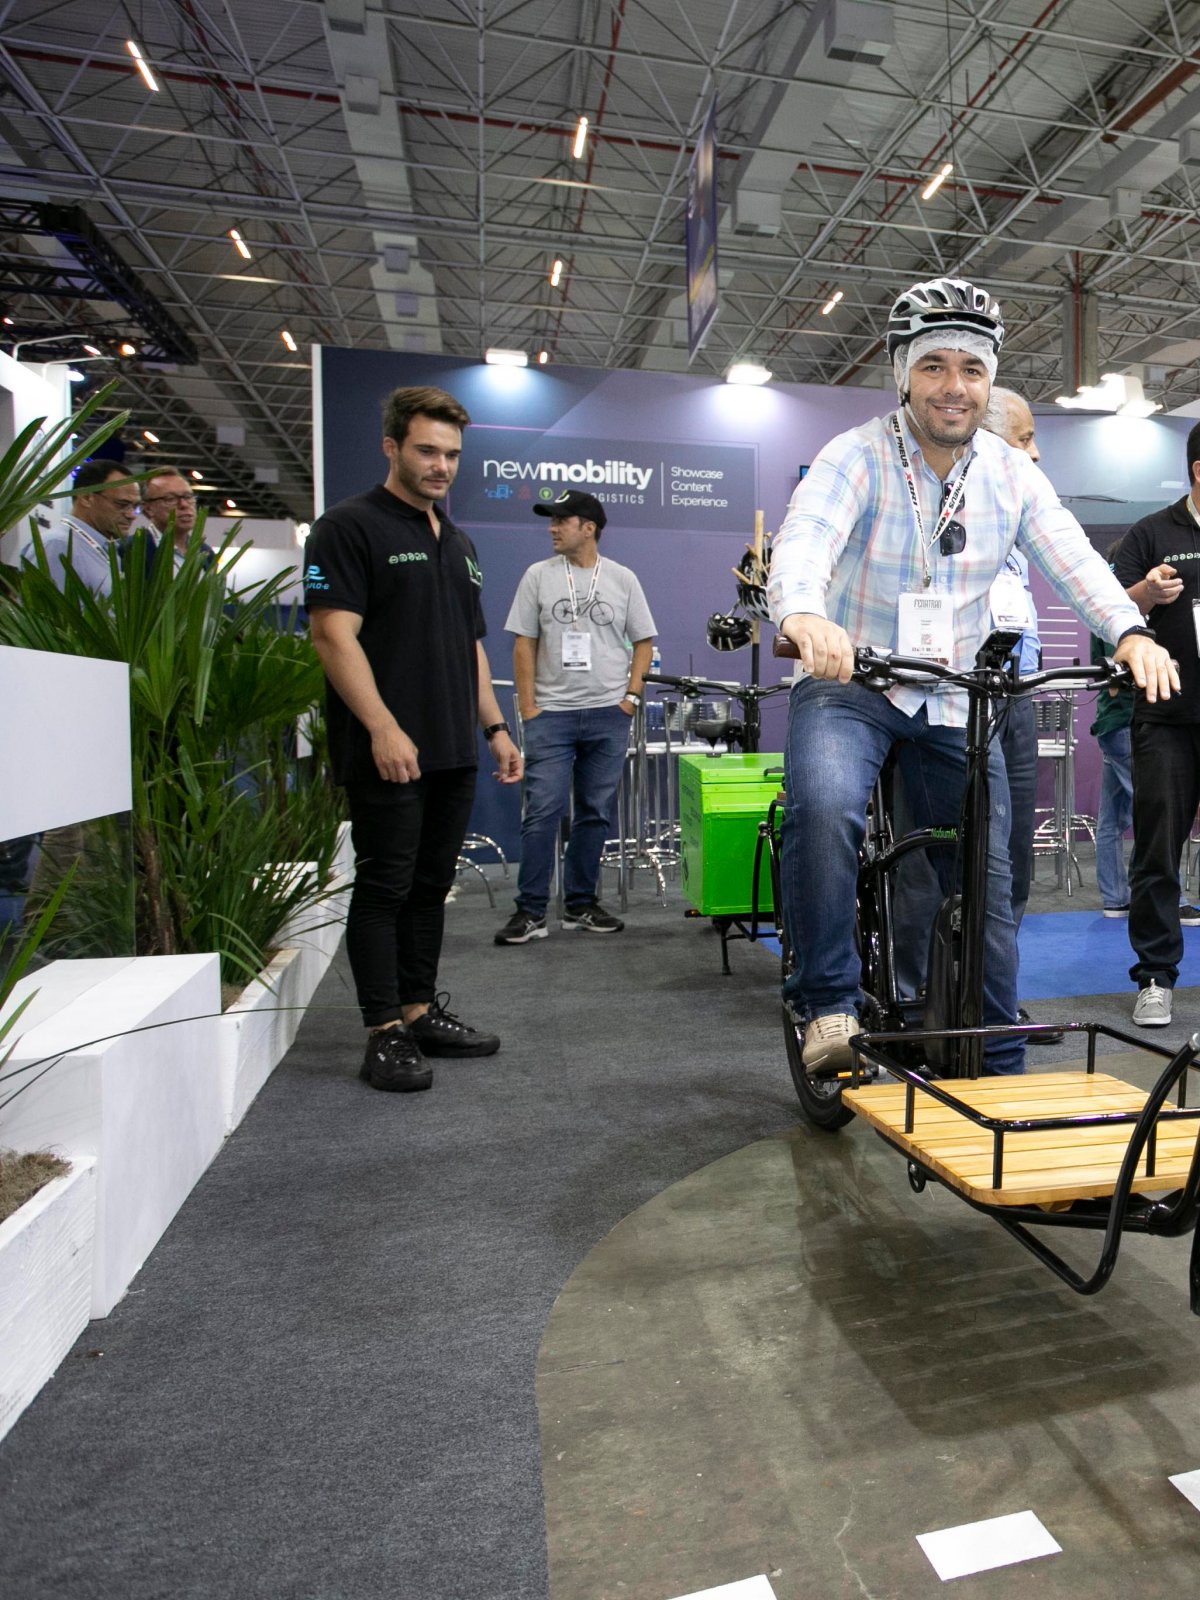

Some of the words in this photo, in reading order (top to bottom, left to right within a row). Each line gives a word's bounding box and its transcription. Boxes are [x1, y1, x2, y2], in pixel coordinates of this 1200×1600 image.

[896, 436, 909, 468] PNEUS
[483, 459, 653, 490] newmobility
[671, 466, 723, 480] Showcase
[671, 480, 712, 493] Content
[590, 492, 645, 505] GISTICS
[671, 494, 728, 507] Experience
